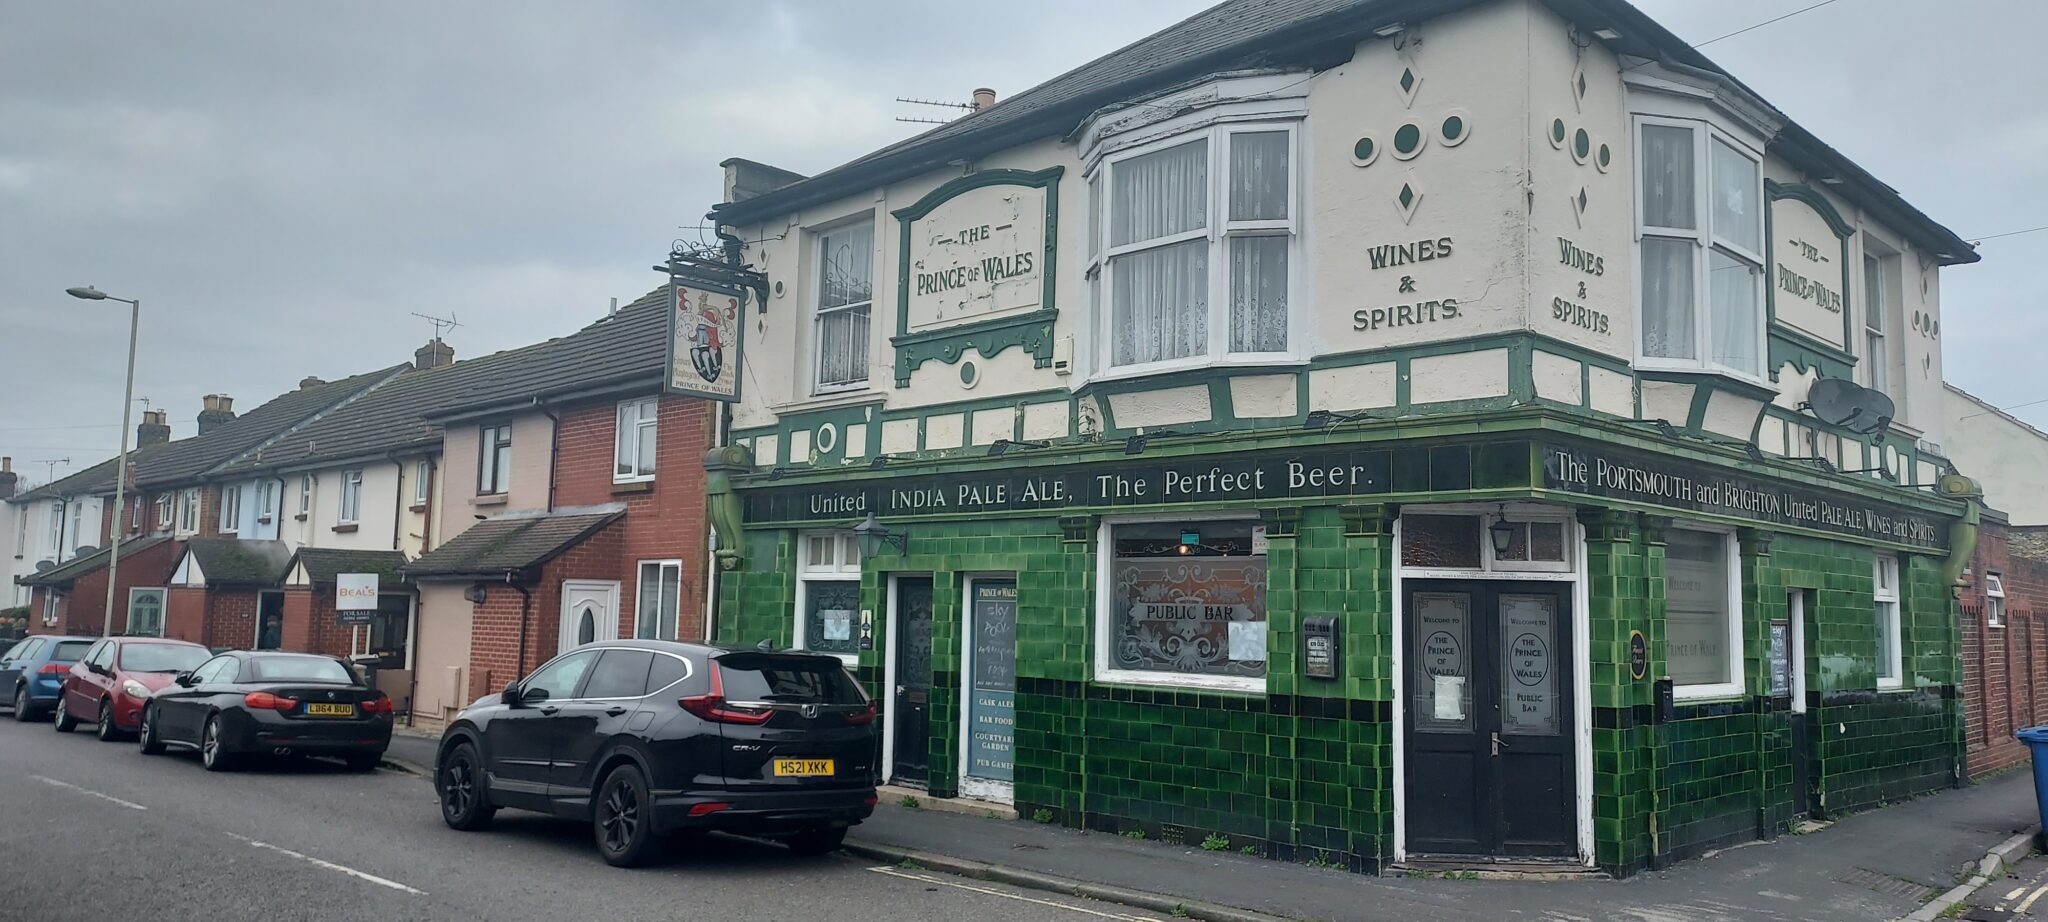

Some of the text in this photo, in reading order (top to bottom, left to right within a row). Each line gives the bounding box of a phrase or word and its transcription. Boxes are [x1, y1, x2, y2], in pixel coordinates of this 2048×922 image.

[959, 225, 990, 245] THE
[1367, 237, 1453, 269] WINES
[1557, 237, 1604, 276] WINES
[1801, 241, 1819, 262] THE
[917, 252, 1033, 296] PRINCE OF WALES
[1399, 275, 1417, 293] &
[1577, 281, 1587, 299] &
[1778, 263, 1808, 300] PRINCE
[1813, 280, 1841, 314] WALES
[1353, 298, 1463, 331] SPIRITS.
[1552, 297, 1611, 336] SPIRITS.
[675, 381, 732, 394] PRINCE OF WALES
[811, 462, 1373, 514] United INDIA PALE ALE, The Perfect Beer.
[1556, 451, 1938, 542] The PORTSMOUTH and BRIGHTON United PALE ALE, WINES and SPIRITS.
[979, 587, 997, 597] PRINCE
[1146, 604, 1233, 620] PUBLIC BAR
[1423, 616, 1450, 624] WELCOME
[1510, 618, 1538, 626] WELCOME
[1434, 636, 1448, 644] THE
[1427, 645, 1455, 655] PRINCE
[1515, 647, 1543, 657] PRINCE
[1428, 666, 1455, 676] WALES
[1516, 669, 1543, 678] WALES
[978, 698, 1014, 708] CASK ALES
[1517, 693, 1543, 702] PUBLIC
[1522, 704, 1537, 713] BAR
[979, 715, 1014, 726] BAR FOOD
[981, 742, 1009, 752] GARDEN
[780, 761, 828, 774] HS21 XKK
[976, 758, 990, 767] PUB
